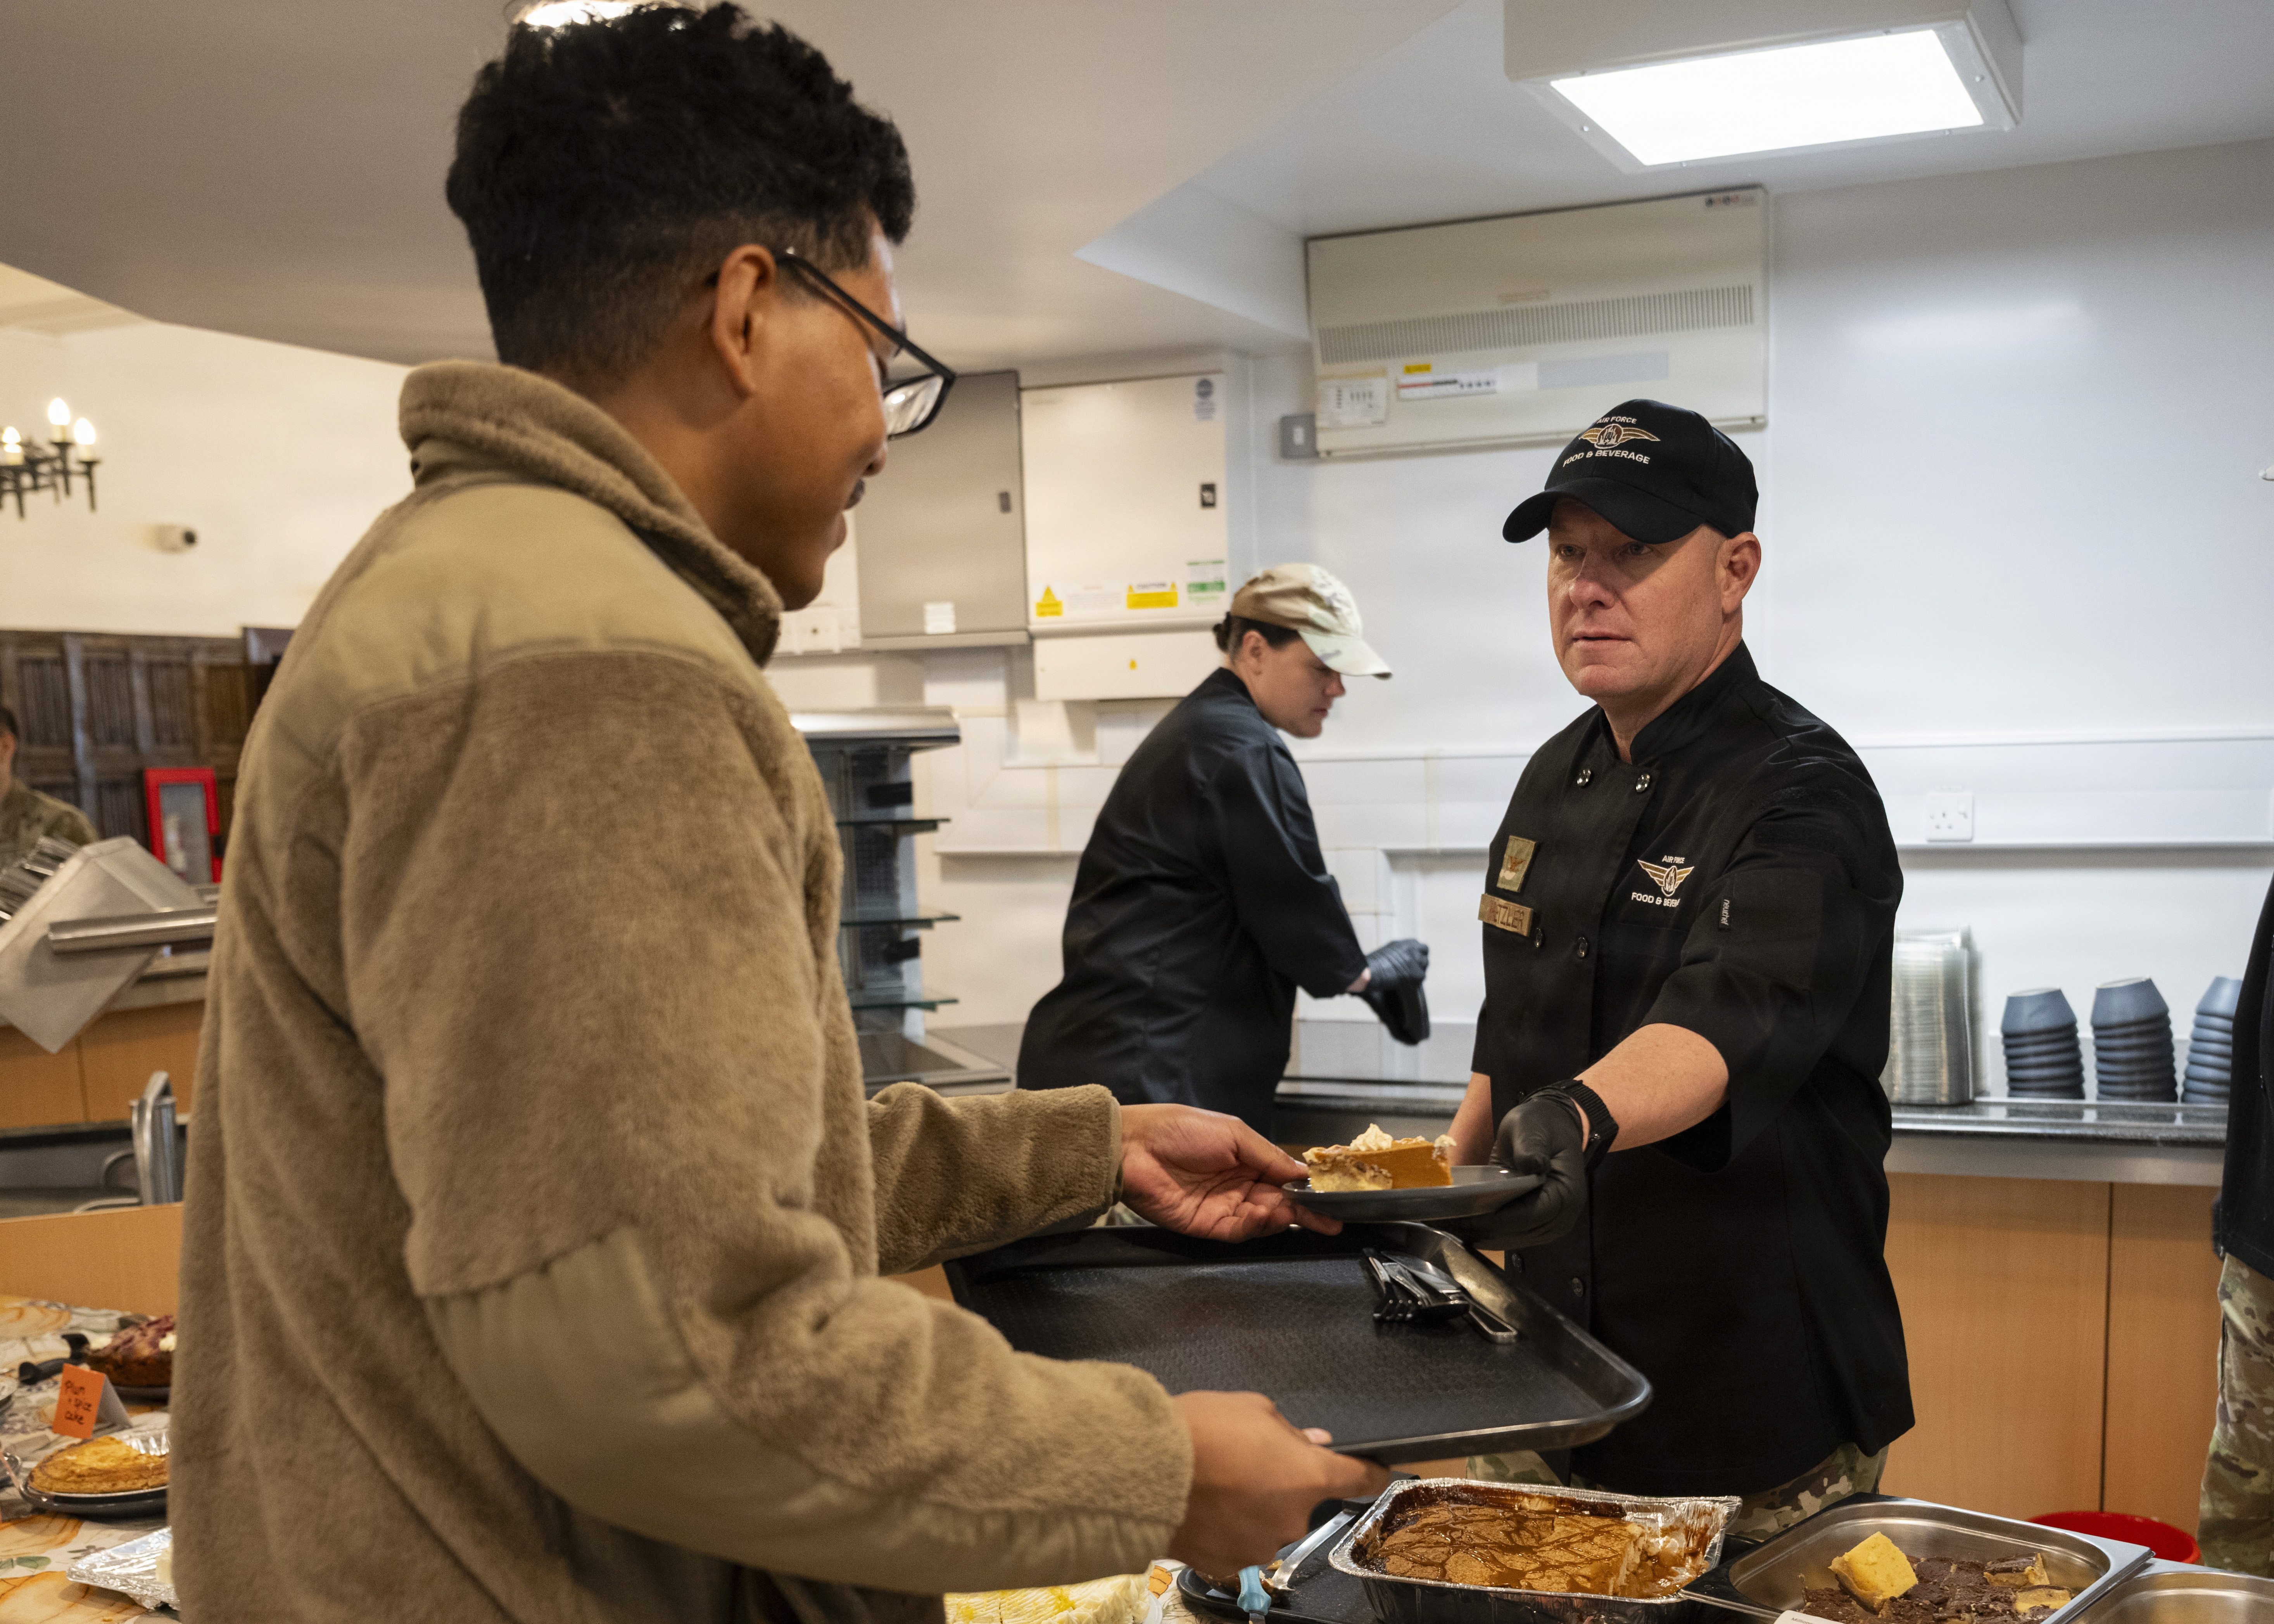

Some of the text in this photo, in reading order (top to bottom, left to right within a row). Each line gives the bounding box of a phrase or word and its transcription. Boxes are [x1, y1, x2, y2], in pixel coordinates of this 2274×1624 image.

[1610, 416, 1637, 424] FORCE
[1563, 452, 1584, 468] FOOD
[1595, 450, 1651, 464] BEVERAGE
[1661, 855, 1674, 863] AIR
[1631, 892, 1654, 903] FOOD
[1655, 897, 1662, 905] &
